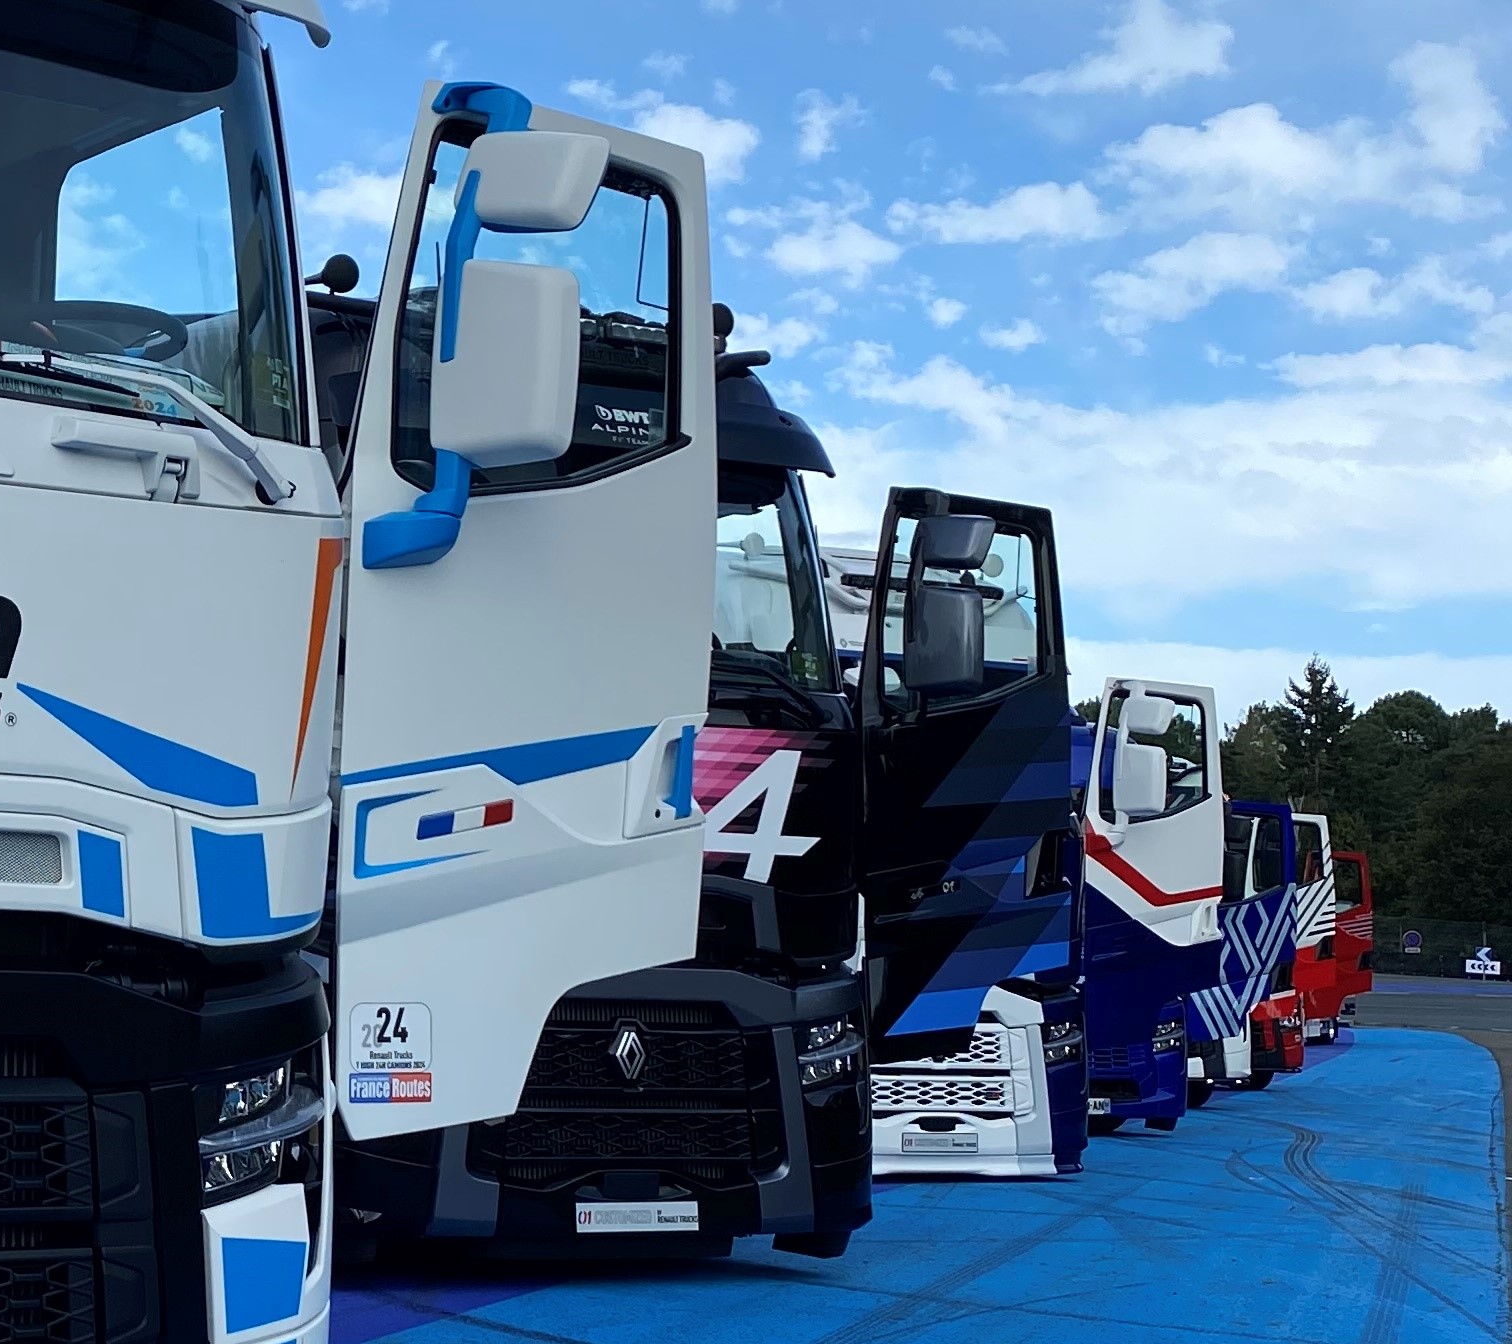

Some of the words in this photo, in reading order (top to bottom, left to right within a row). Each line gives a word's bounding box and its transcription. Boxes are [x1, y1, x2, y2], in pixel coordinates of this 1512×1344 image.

[28, 381, 63, 399] TRUCKS
[131, 397, 177, 417] 2024
[612, 408, 650, 425] BWT
[369, 1050, 393, 1060] Renault
[394, 1051, 413, 1060] Trucks
[350, 1078, 390, 1099] France
[392, 1078, 431, 1099] Routes
